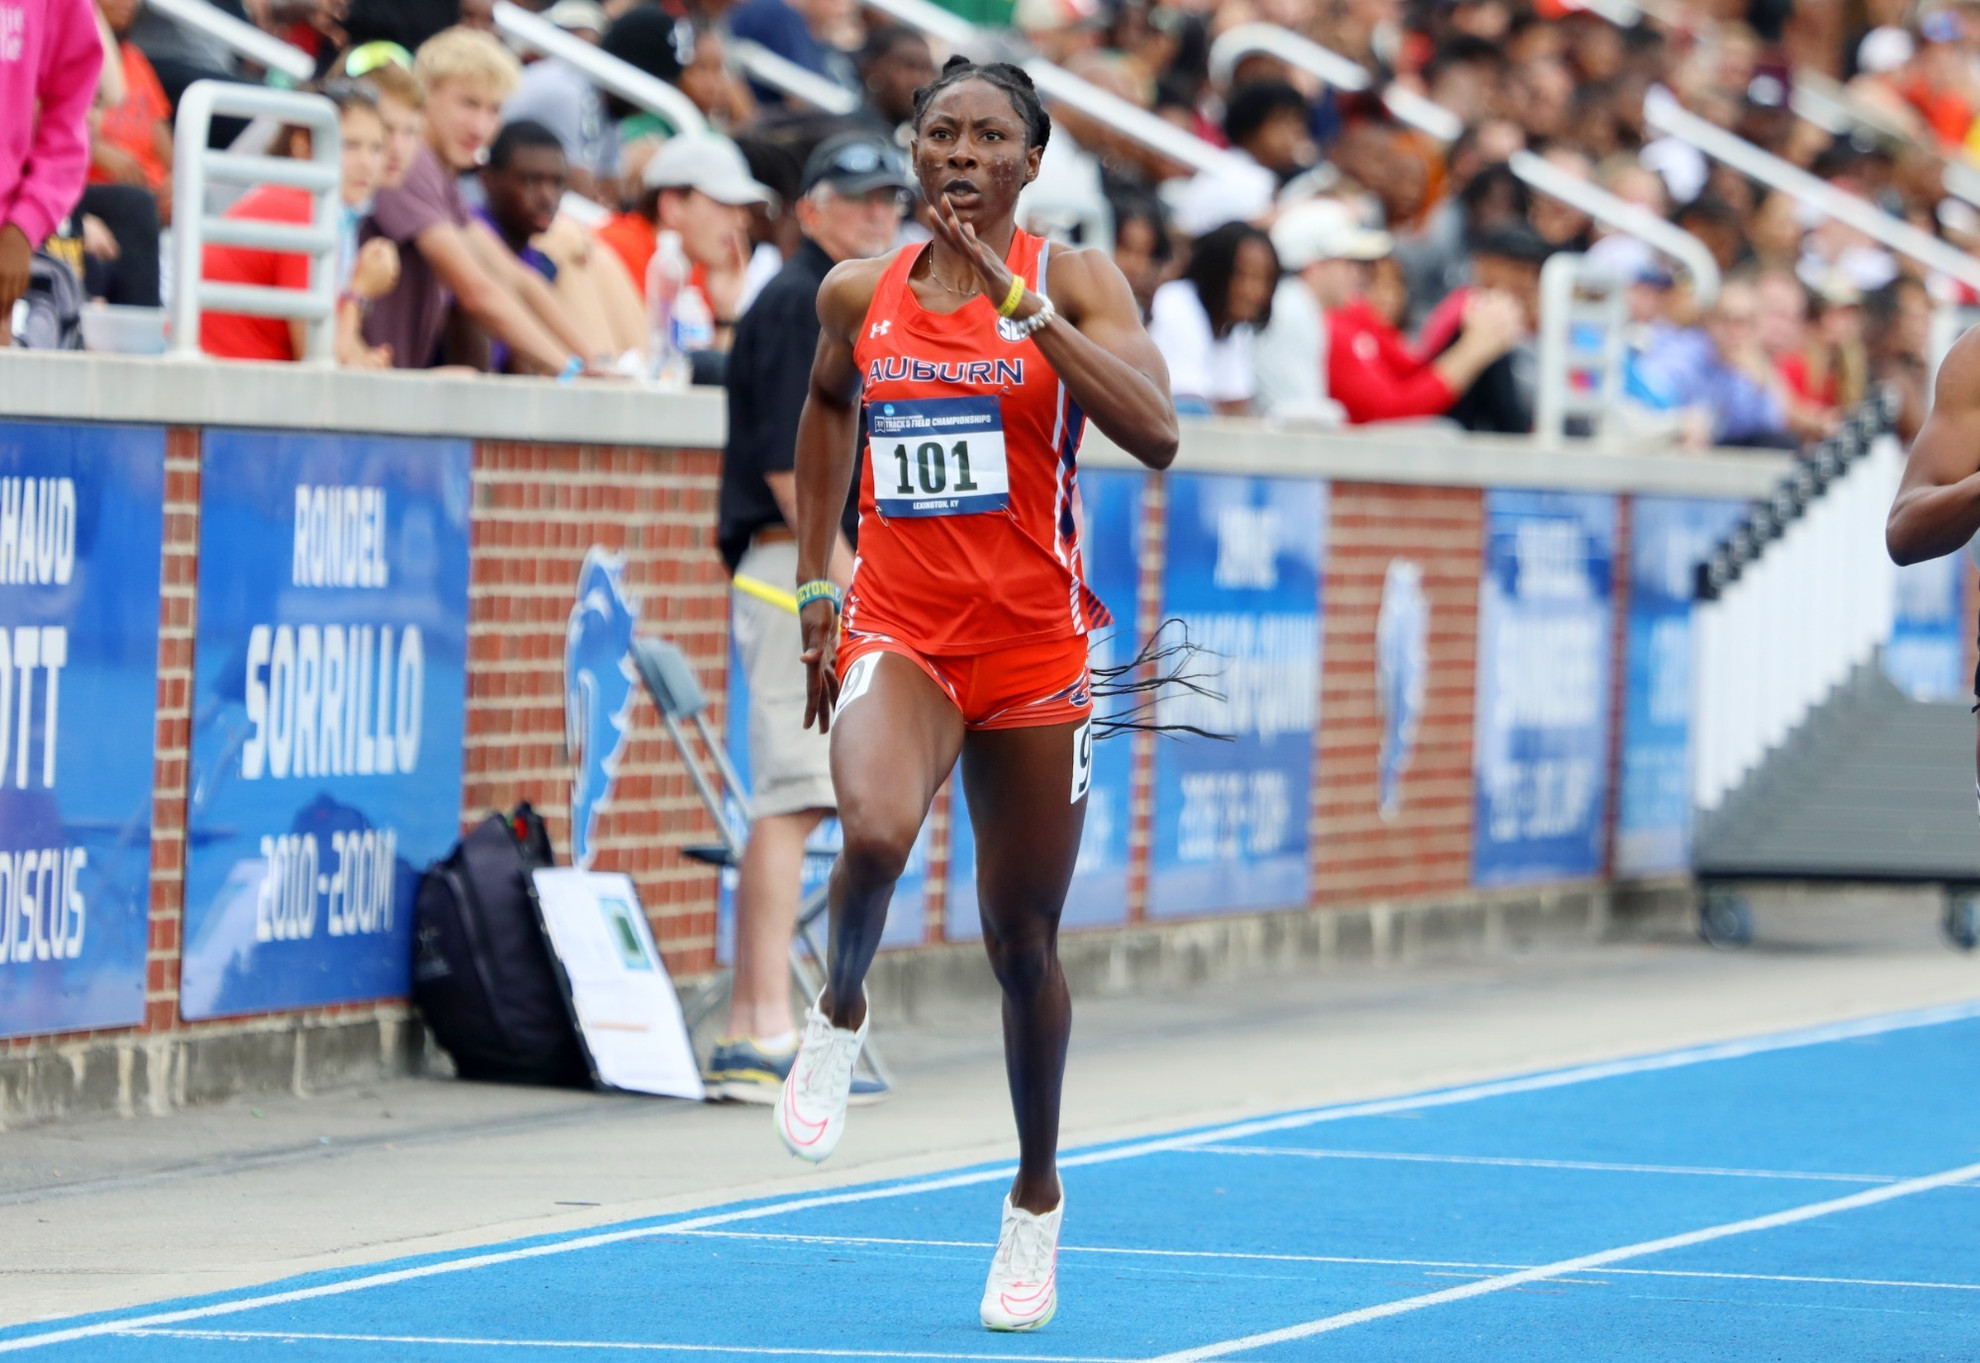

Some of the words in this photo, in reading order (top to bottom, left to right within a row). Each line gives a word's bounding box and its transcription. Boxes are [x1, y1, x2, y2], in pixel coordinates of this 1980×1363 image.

[867, 356, 1024, 387] AUBURN
[885, 419, 905, 429] TRACK
[911, 418, 931, 428] FIELD
[931, 414, 991, 426] CHAMPIONSHIPS
[894, 441, 978, 494] 101
[0, 475, 76, 585] HAUD
[292, 484, 389, 588] RONDEL
[242, 623, 424, 780] SORRILLO
[838, 660, 866, 710] 9
[1078, 723, 1090, 793] 9
[0, 847, 87, 964] DISCUS
